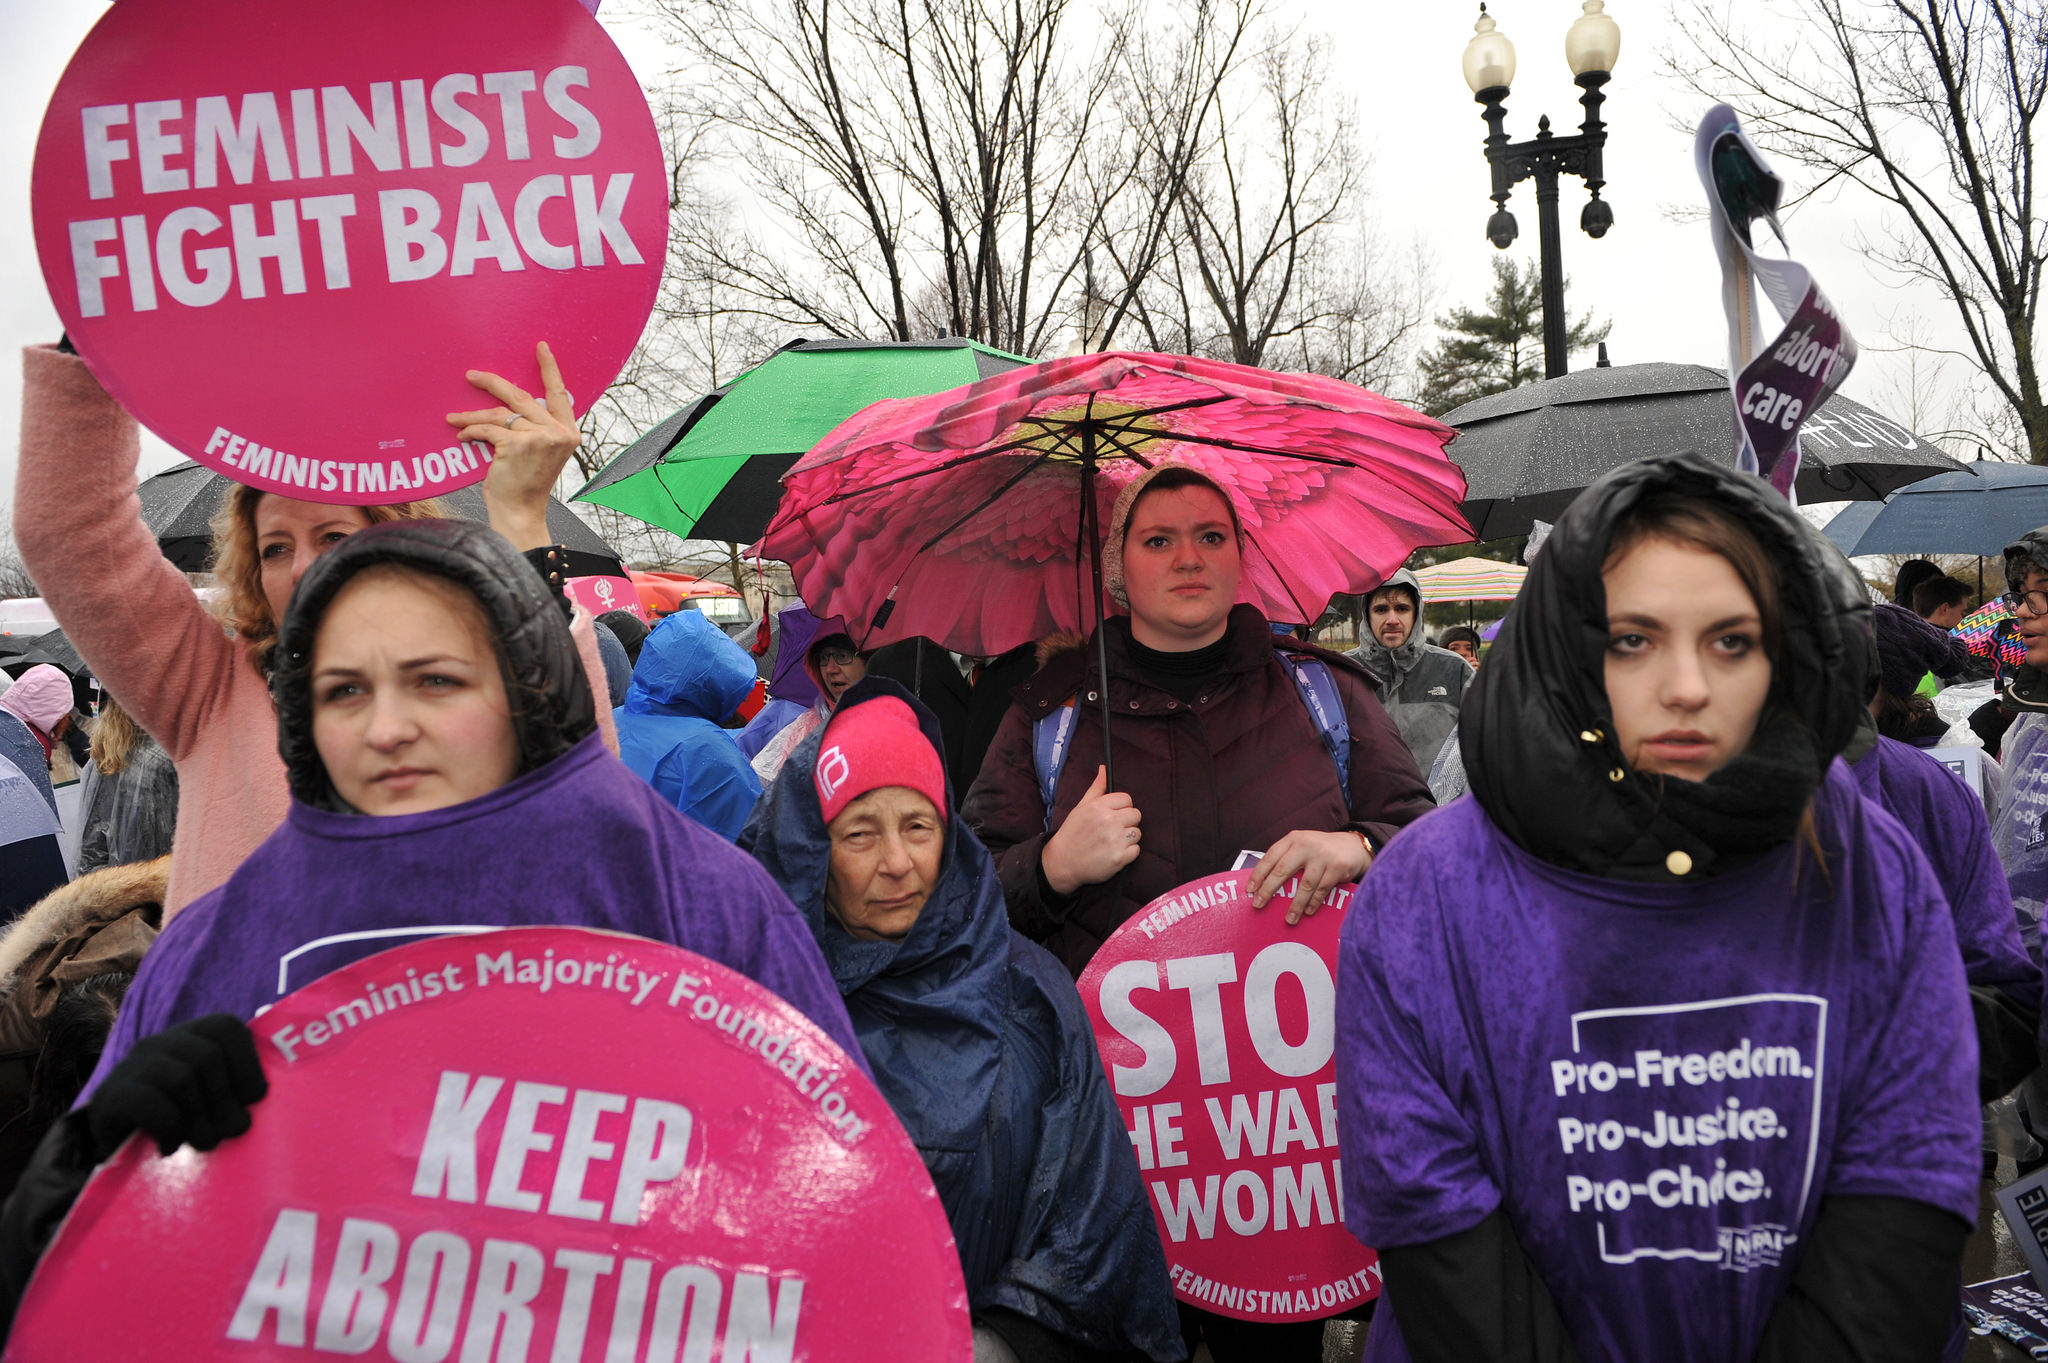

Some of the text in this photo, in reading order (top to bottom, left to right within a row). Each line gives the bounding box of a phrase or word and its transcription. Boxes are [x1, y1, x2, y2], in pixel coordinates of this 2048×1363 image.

[80, 65, 602, 200] FEMINISTS
[68, 172, 646, 318] FIGHT BACK
[1742, 382, 1803, 431] care
[1139, 879, 1238, 940] FEMINIST
[270, 949, 869, 1144] Feminist Majority Foundation
[1099, 941, 1336, 1098] STO
[411, 1069, 693, 1227] KEEP
[1119, 1101, 1190, 1171] HE
[1151, 1159, 1345, 1244] WOM
[226, 1208, 805, 1363] ABORTION
